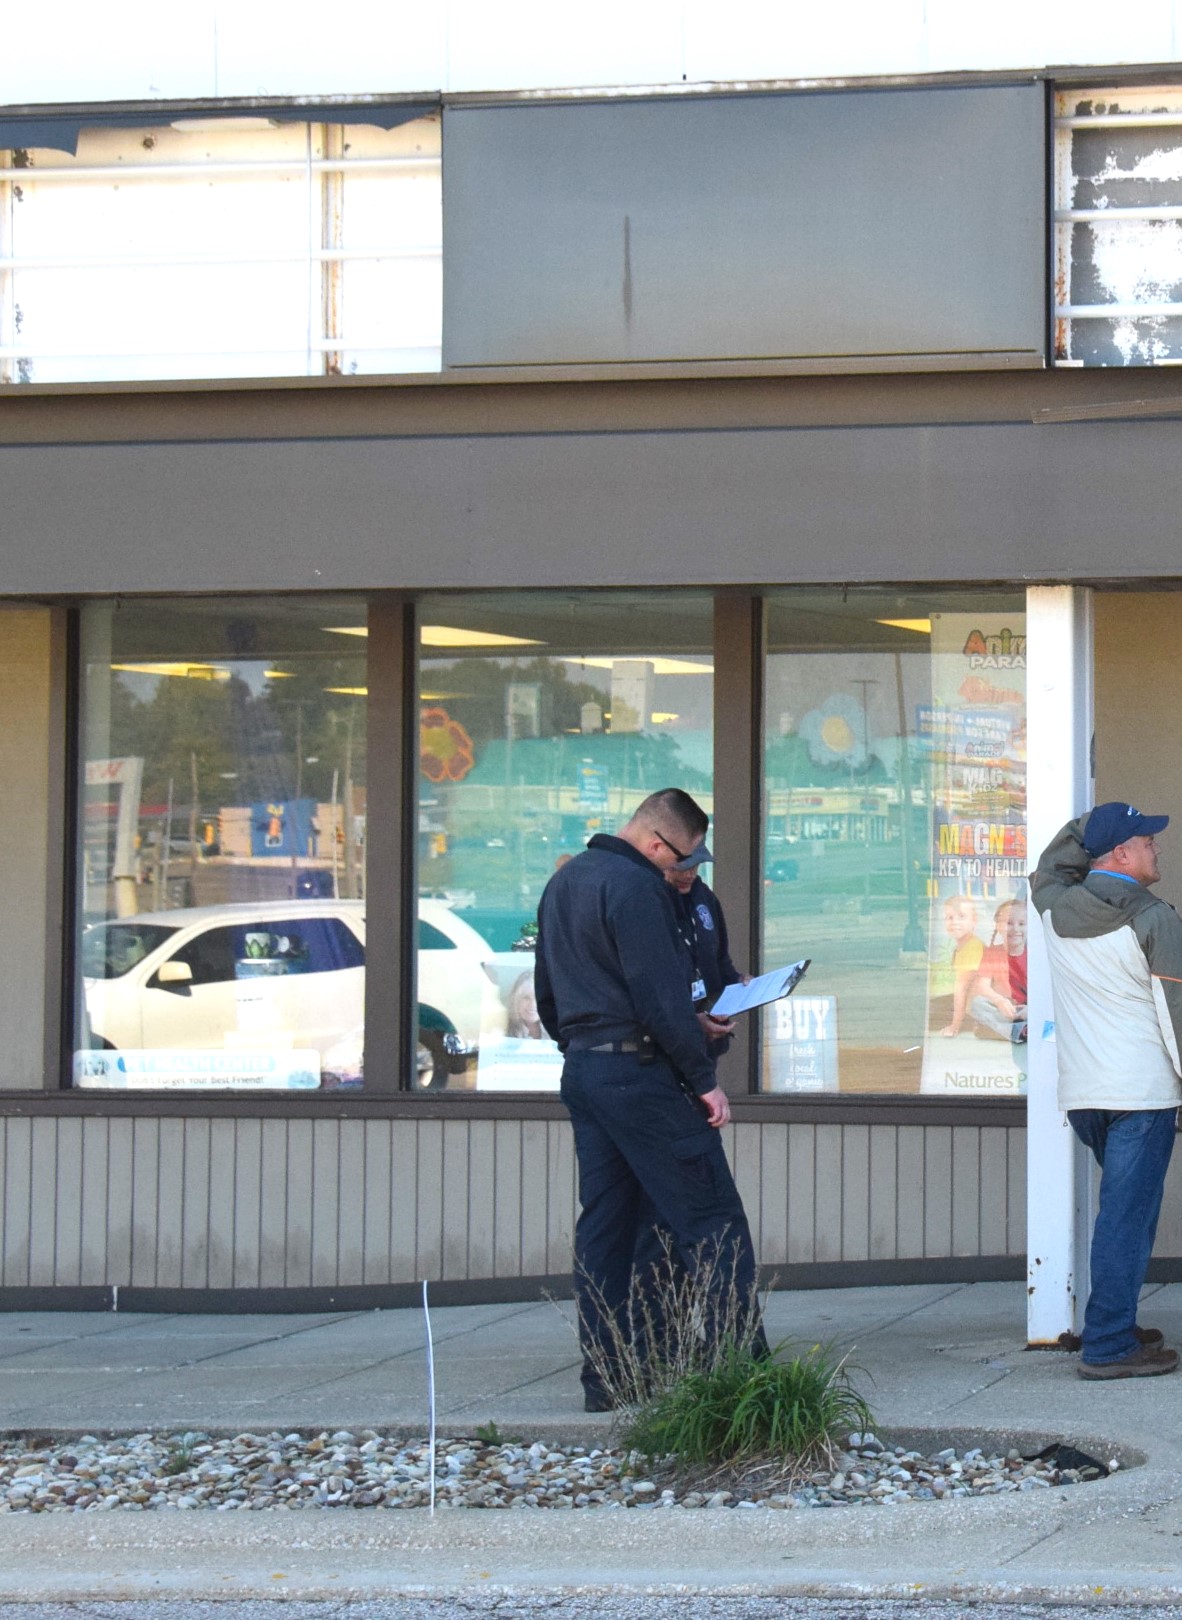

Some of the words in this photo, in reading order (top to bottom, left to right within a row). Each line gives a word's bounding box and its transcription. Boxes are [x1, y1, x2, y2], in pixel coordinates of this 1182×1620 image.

[962, 767, 1004, 784] MAG
[939, 823, 1027, 857] MAGNES
[939, 858, 961, 877] KEY
[965, 858, 982, 877] TO
[775, 999, 830, 1040] BUY
[217, 1056, 271, 1072] CENTER
[944, 1072, 1014, 1089] Natures
